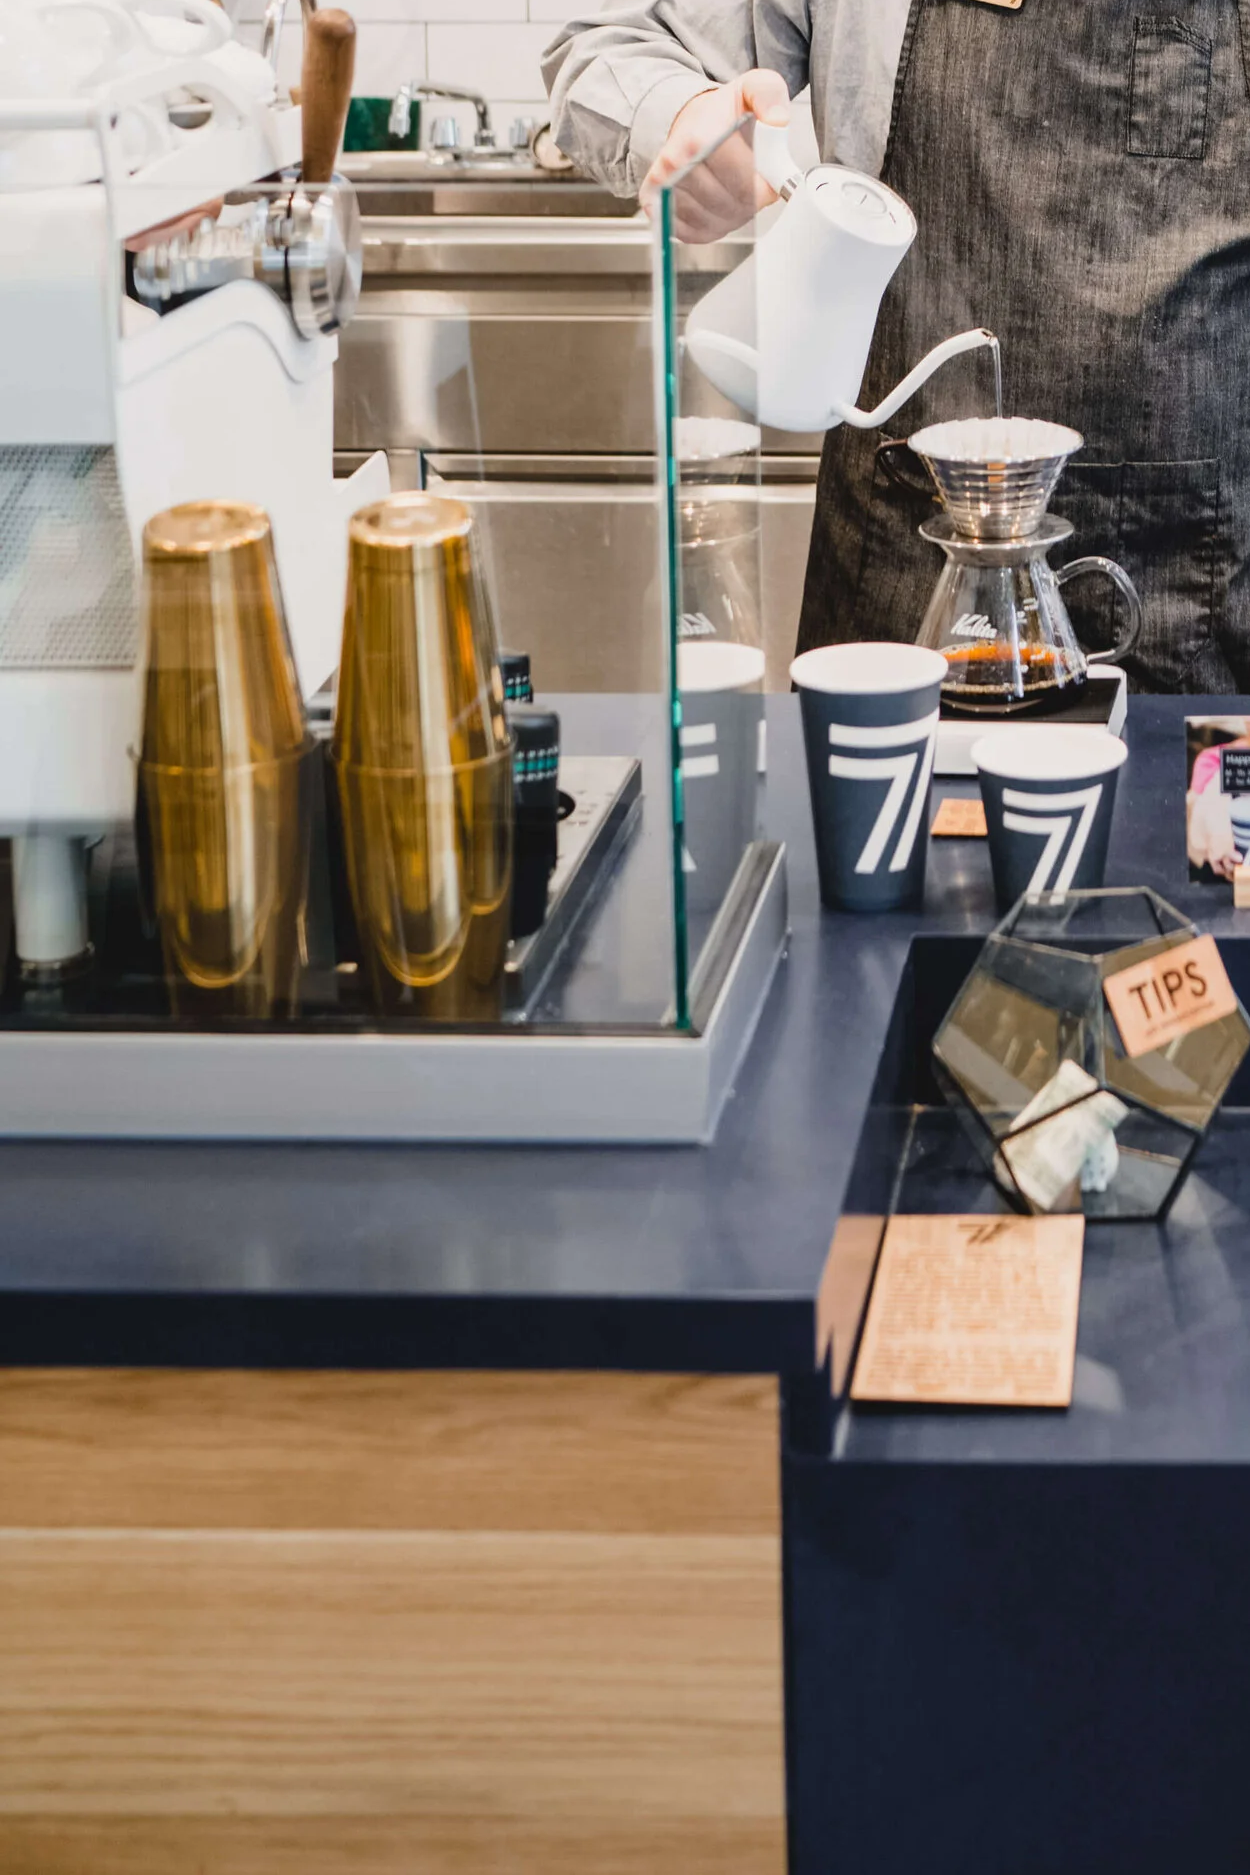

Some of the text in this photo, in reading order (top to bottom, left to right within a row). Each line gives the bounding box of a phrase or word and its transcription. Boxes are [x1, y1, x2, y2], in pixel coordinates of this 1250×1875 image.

[951, 613, 998, 639] Kalita
[829, 707, 940, 875] 7
[1002, 783, 1104, 905] 7
[1129, 961, 1207, 1020] TIPS
